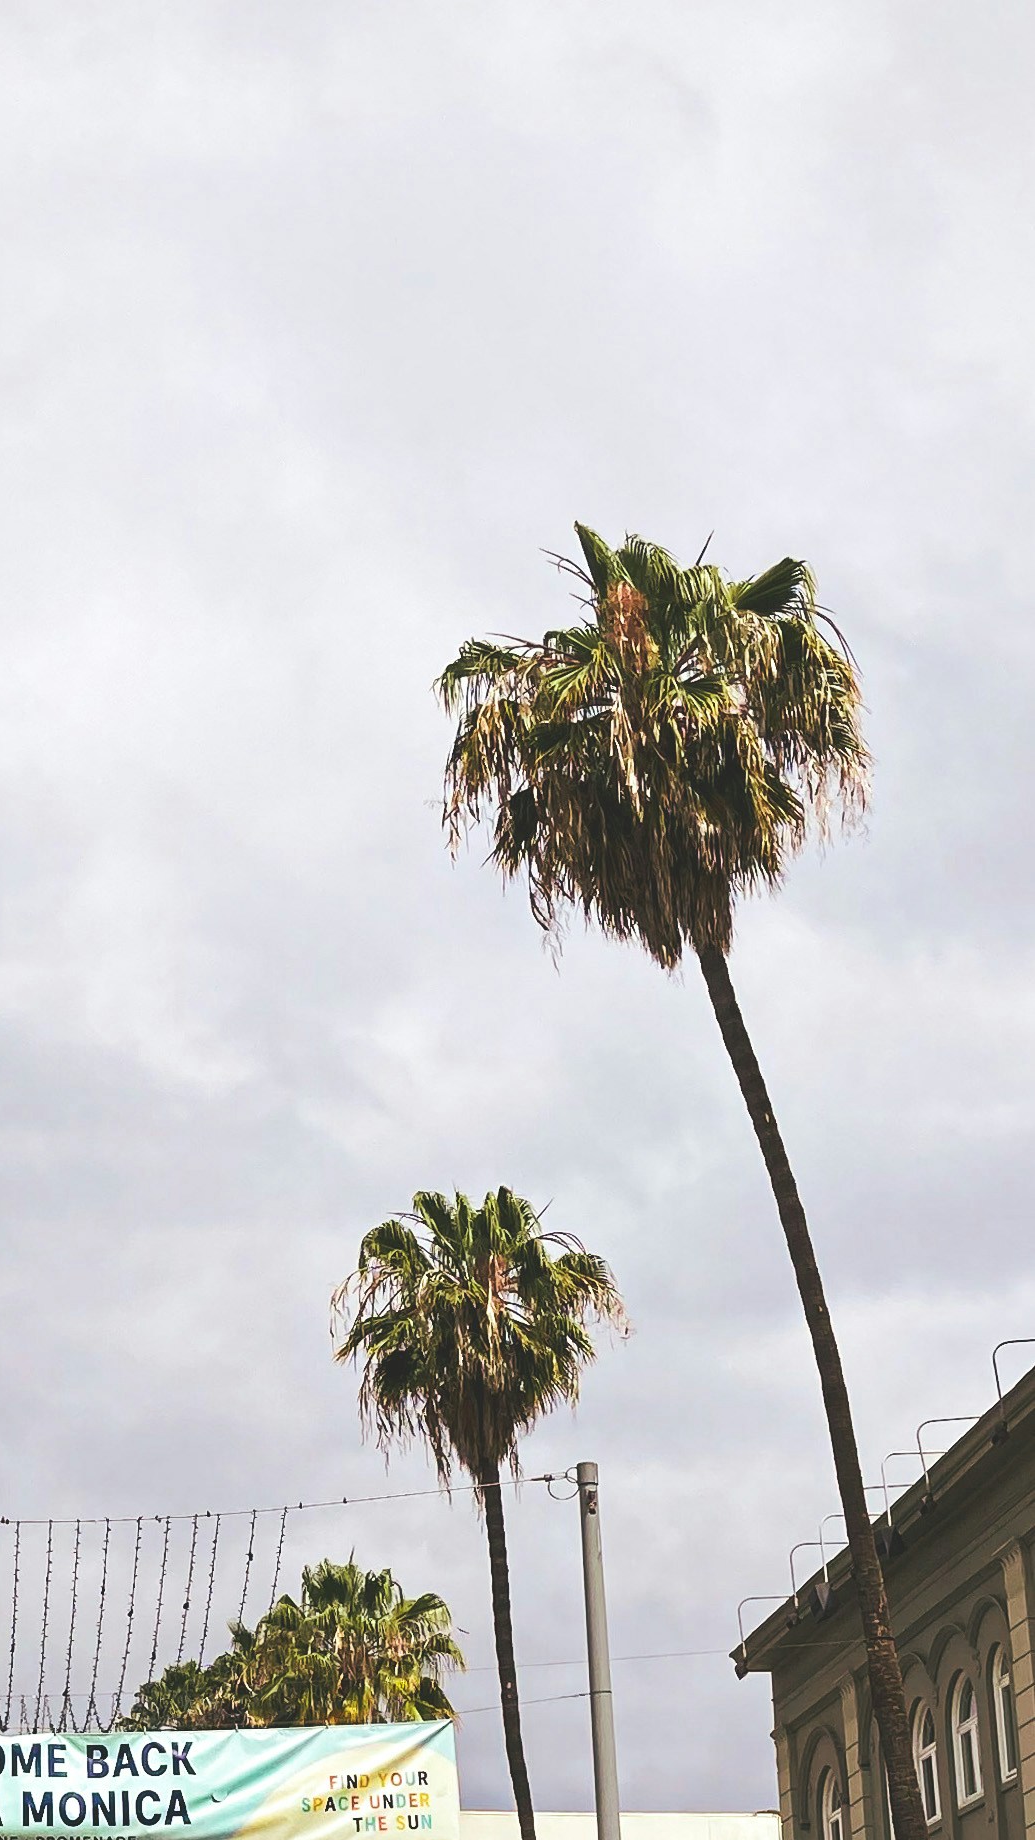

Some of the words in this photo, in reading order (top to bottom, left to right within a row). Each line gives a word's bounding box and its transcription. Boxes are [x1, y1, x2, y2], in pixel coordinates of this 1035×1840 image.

[87, 1741, 196, 1778] BACK
[329, 1774, 370, 1789] FIND
[378, 1771, 428, 1788] YOUR
[22, 1789, 192, 1826] MONICA
[301, 1796, 360, 1812] SPACE
[370, 1793, 430, 1809] UNDER
[352, 1816, 388, 1832] THE
[396, 1814, 432, 1830] SUN
